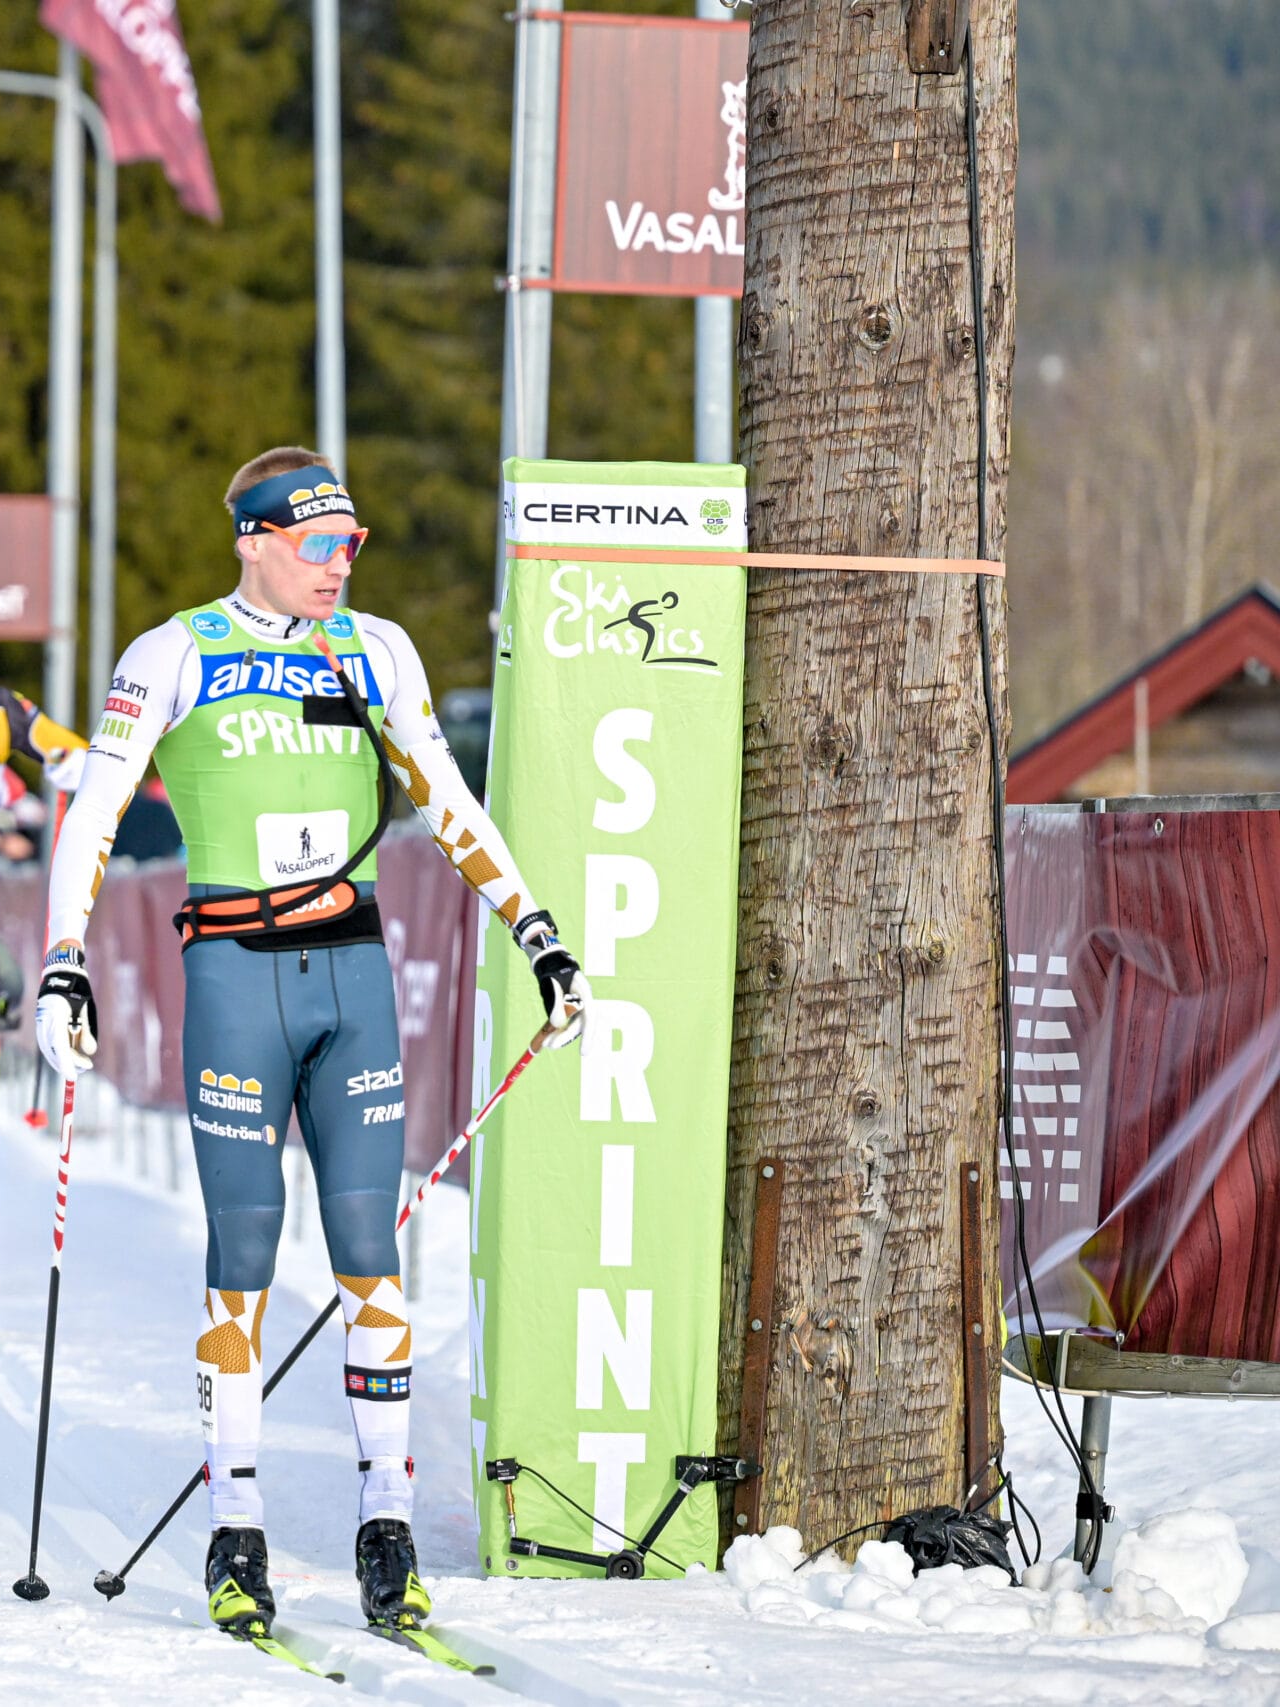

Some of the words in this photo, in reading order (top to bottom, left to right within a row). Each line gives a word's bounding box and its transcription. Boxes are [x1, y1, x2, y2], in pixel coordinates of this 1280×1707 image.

[523, 503, 689, 526] CERTINA
[549, 565, 632, 622] Ski
[230, 600, 276, 628] TRIMTEX
[217, 709, 361, 758] SPRINT
[275, 853, 336, 874] VASALOPPET
[199, 1087, 262, 1114] EKSJÖHUS
[192, 1113, 262, 1142] Sundström
[577, 708, 660, 1552] SPRINT
